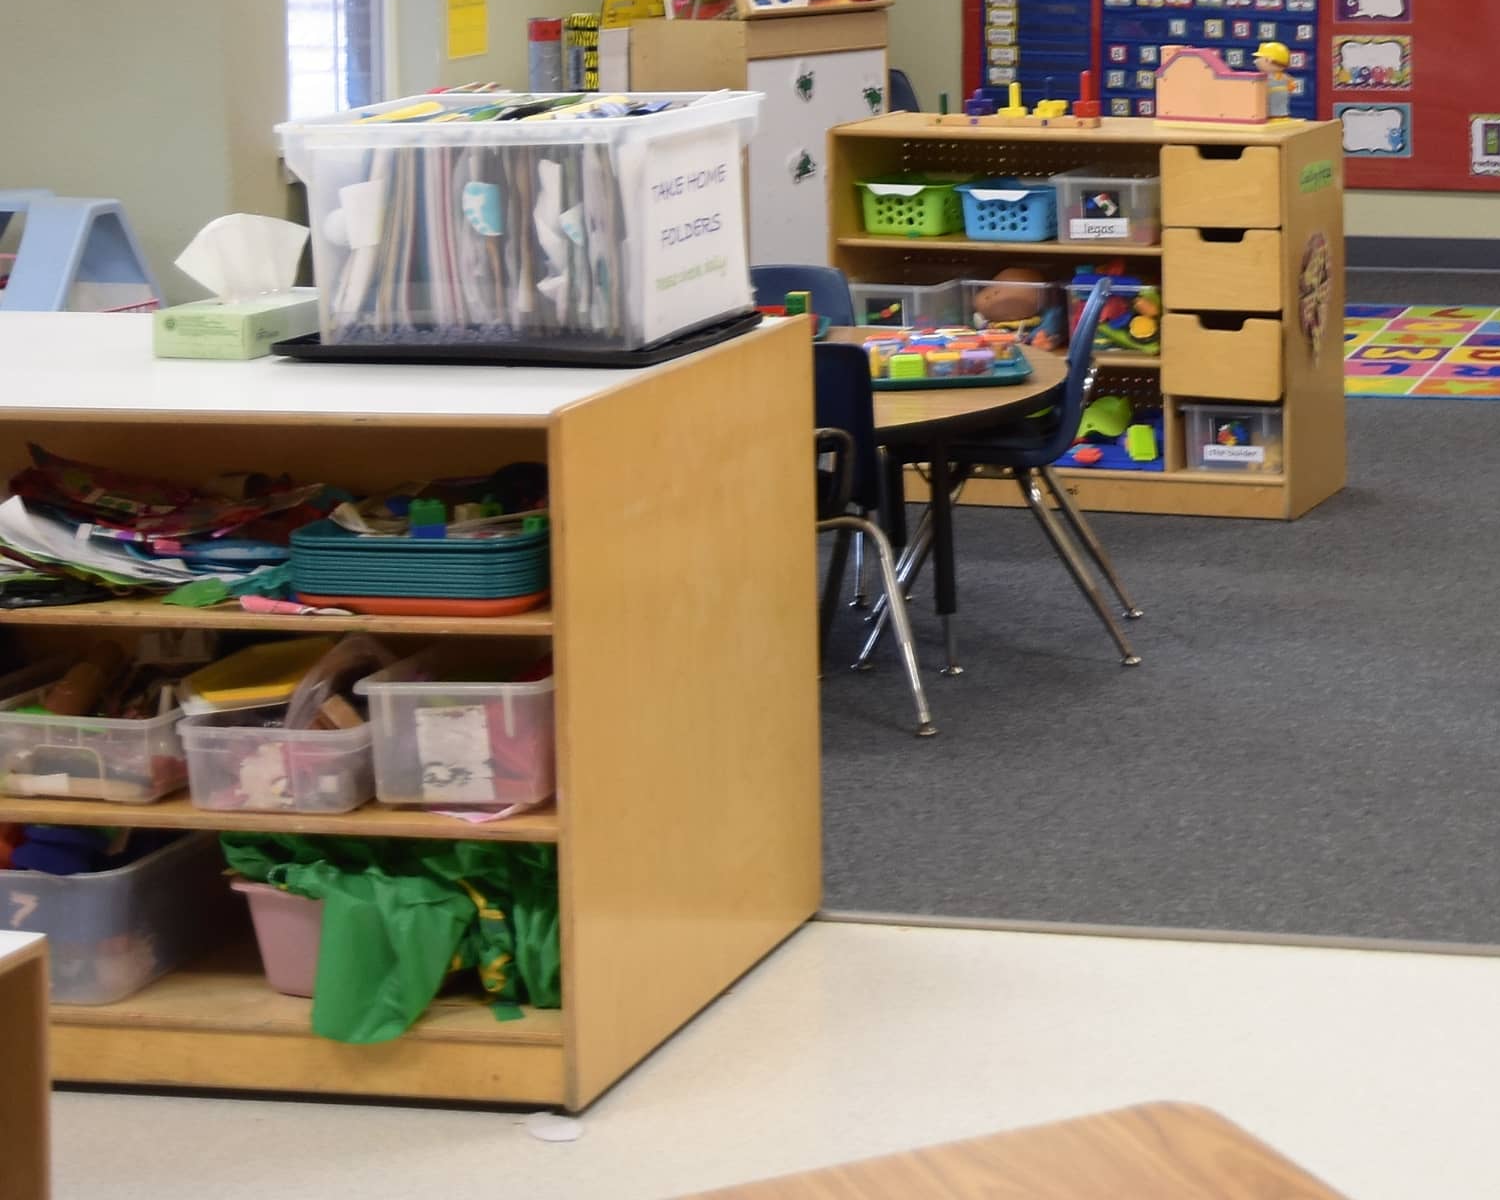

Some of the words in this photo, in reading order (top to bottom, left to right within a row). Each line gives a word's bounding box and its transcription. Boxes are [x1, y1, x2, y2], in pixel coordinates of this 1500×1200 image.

[651, 175, 684, 202] TAKE
[687, 163, 727, 192] HOME
[660, 213, 721, 250] FOLDERS
